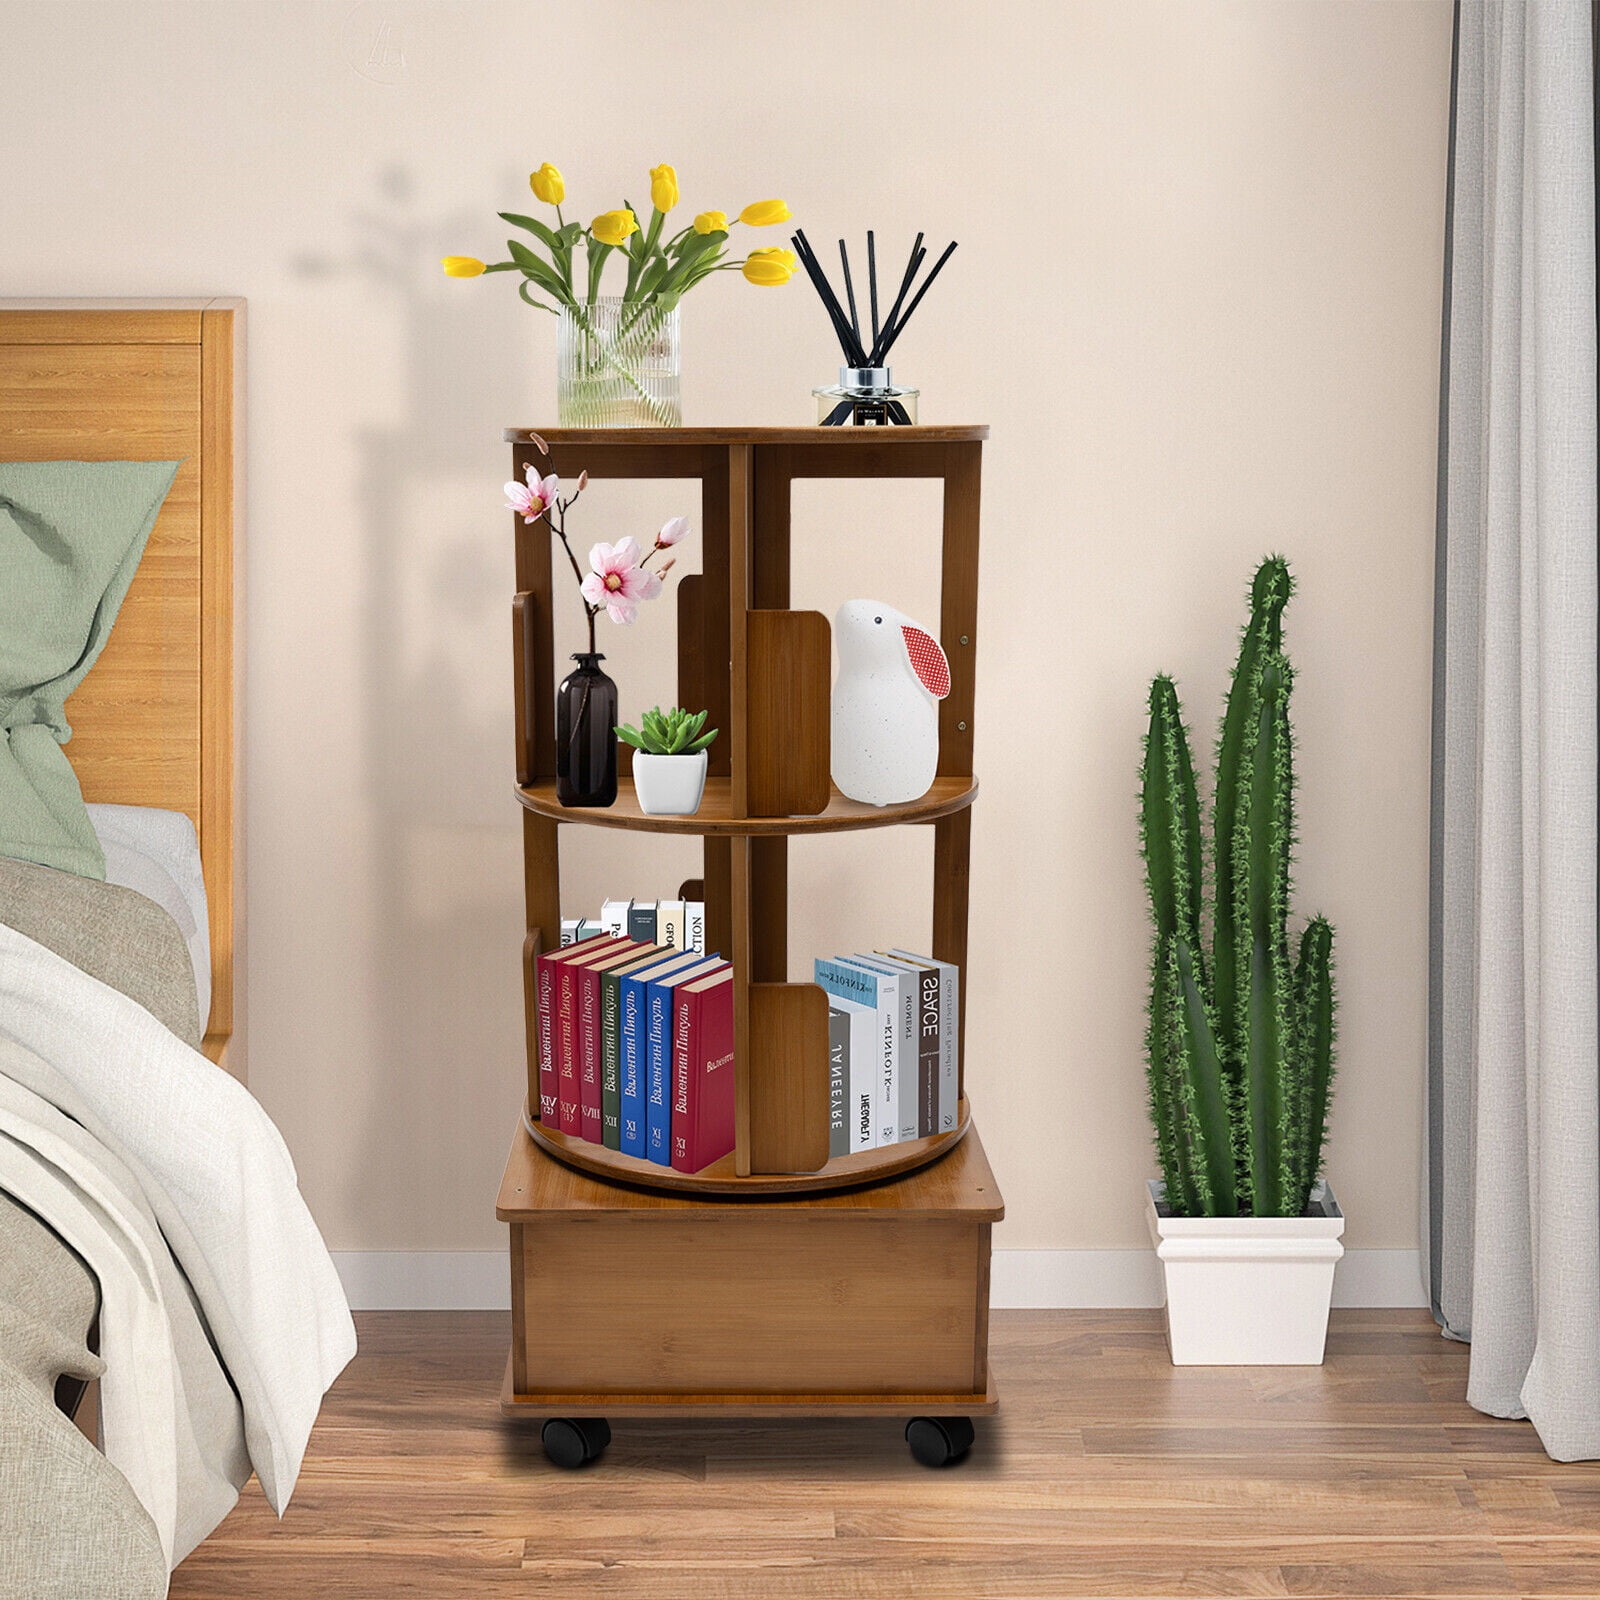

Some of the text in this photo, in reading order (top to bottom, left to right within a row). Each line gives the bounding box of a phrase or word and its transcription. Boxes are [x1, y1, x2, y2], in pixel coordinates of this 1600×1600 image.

[540, 969, 552, 1072] Валентин Пикуль
[560, 976, 572, 1078] Валентин Пикуль
[582, 979, 594, 1083] Валентин Пикуль
[603, 984, 616, 1092] Валентин Пикуль
[624, 991, 638, 1098] Валентин Пикуль
[650, 997, 663, 1106] Валентин Пикуль
[675, 1003, 690, 1114] Валентин Пикуль
[541, 1095, 557, 1108] XIV
[561, 1101, 577, 1115] XIV
[581, 1105, 601, 1119] XVIII
[605, 1115, 617, 1128] XII
[626, 1120, 636, 1131] XI
[676, 1137, 686, 1149] XI
